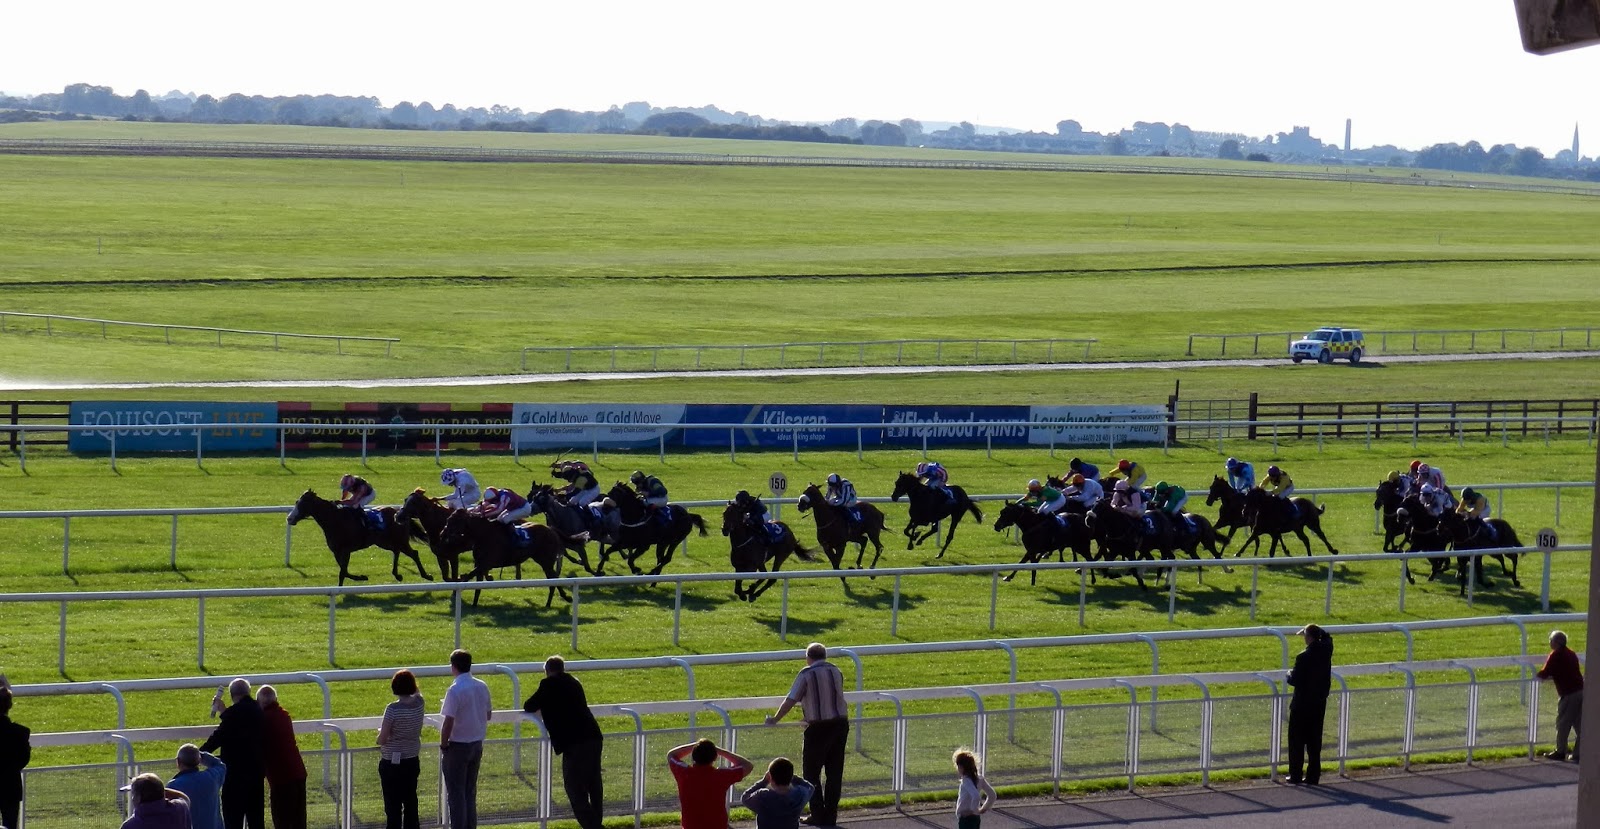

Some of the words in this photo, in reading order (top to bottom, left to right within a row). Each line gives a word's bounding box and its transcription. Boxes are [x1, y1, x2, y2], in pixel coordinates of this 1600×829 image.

[81, 411, 202, 440] EQUISOFT
[211, 412, 264, 437] LIVE
[532, 411, 557, 424] Cold
[560, 412, 589, 424] Move
[606, 411, 631, 424] Cold
[633, 411, 662, 424] Move
[763, 411, 827, 432] Kilsaran
[904, 411, 974, 438] Fleetwood
[977, 419, 1026, 437] PAINTS
[1032, 411, 1112, 433] Loughwood
[282, 418, 306, 434] BIG
[312, 418, 342, 434] BAD
[346, 418, 376, 435] BOB
[422, 418, 446, 435] BIG
[450, 418, 479, 435] BAD
[484, 419, 511, 435] BOB
[771, 477, 786, 490] 150
[1539, 534, 1556, 548] 150
